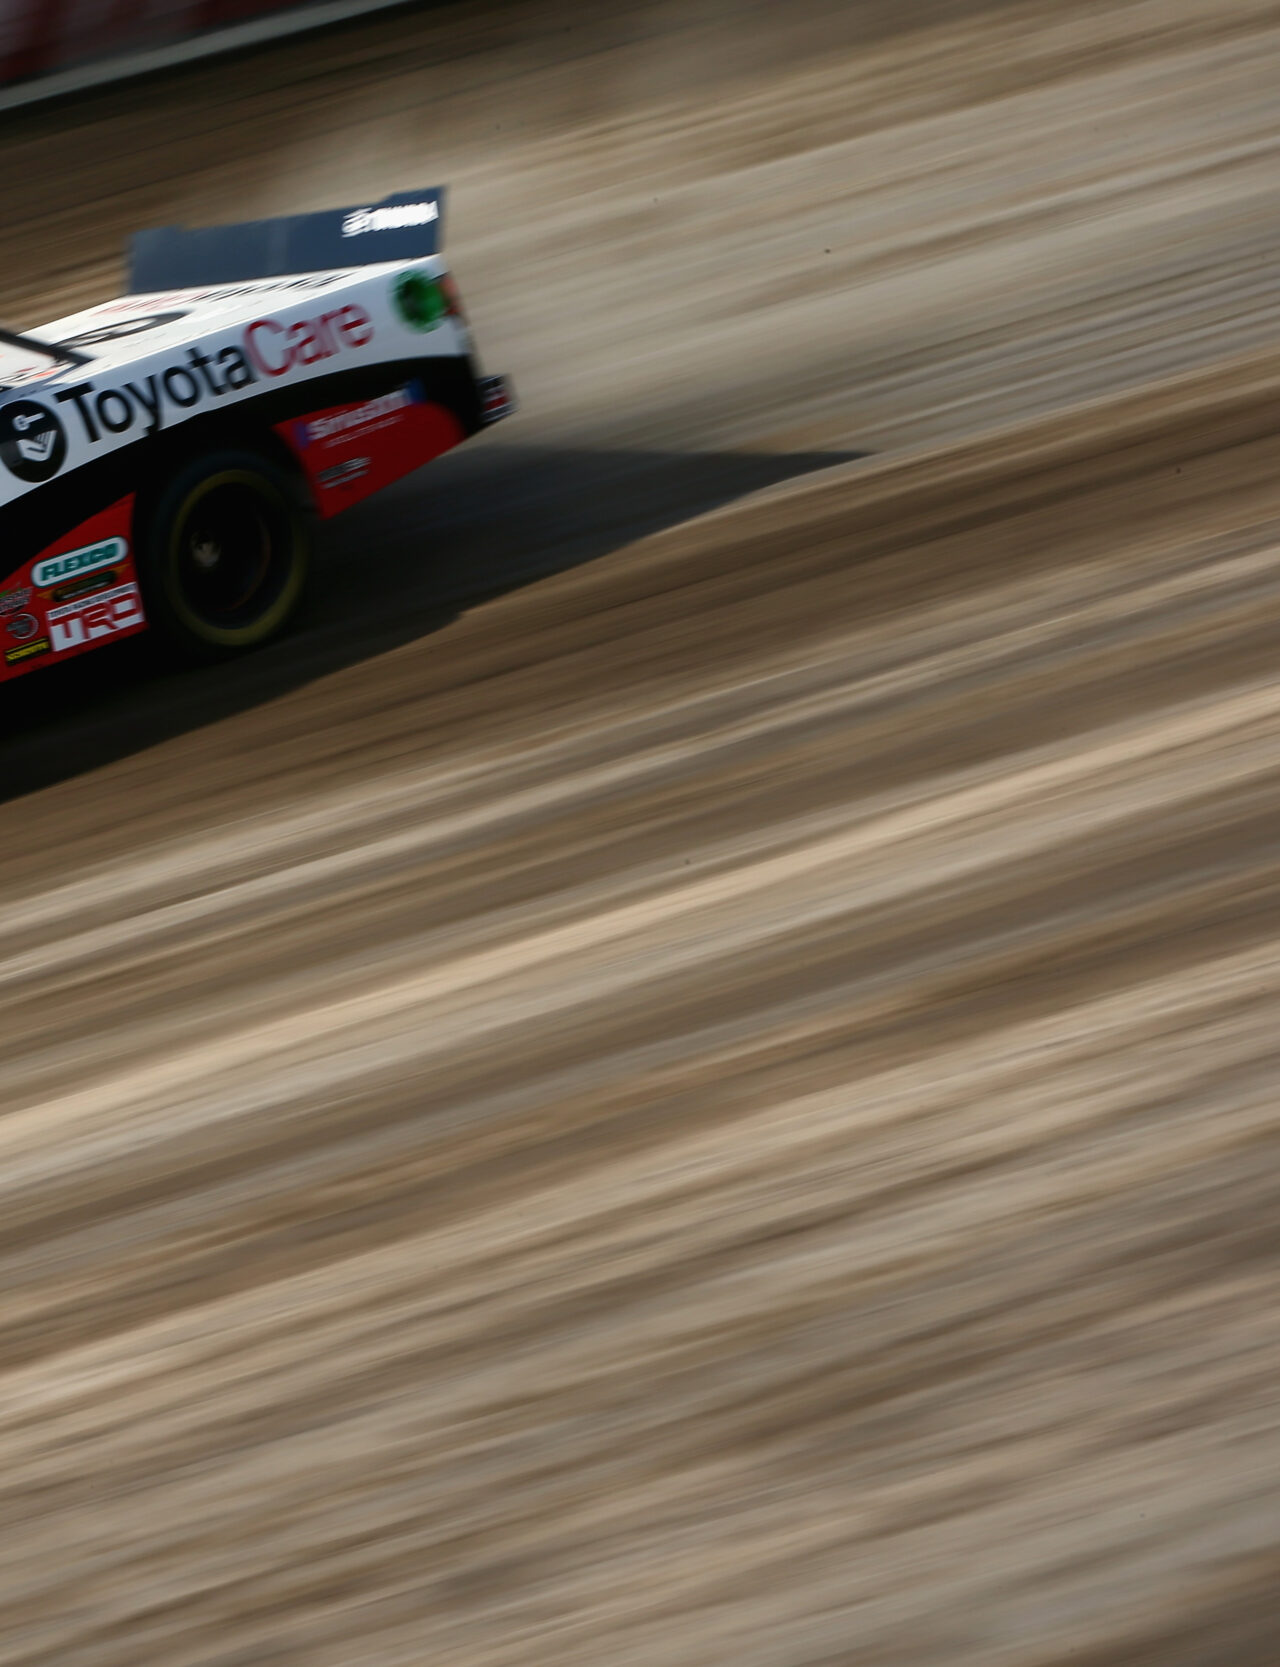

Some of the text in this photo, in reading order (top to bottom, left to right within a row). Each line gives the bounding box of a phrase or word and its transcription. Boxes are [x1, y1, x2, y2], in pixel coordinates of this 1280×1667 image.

[54, 304, 374, 436] ToyotaCare
[40, 542, 119, 582] FLEXCO
[49, 592, 144, 643] TRD
